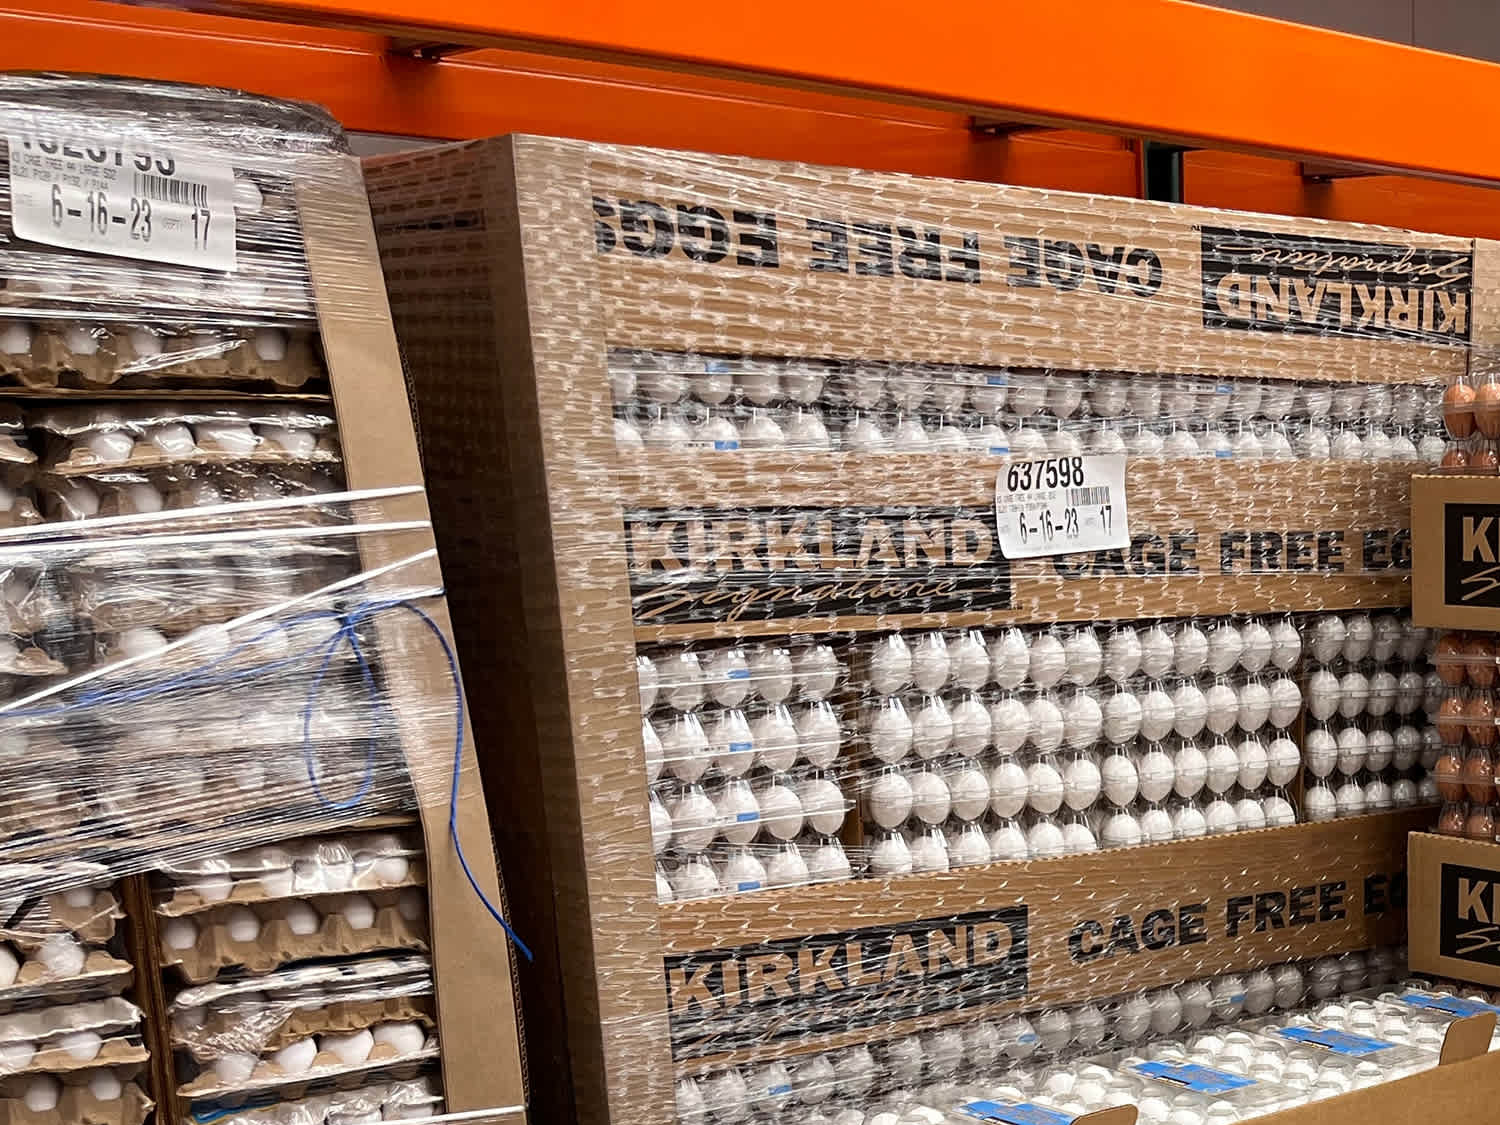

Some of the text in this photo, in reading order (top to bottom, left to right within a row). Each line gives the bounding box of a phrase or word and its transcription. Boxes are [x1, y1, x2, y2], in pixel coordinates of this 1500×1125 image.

[51, 183, 153, 243] 6-16-23
[191, 206, 212, 250] 17
[592, 197, 1163, 298] CAGE FREE EGGS
[1217, 270, 1468, 335] KIRKLAND
[1007, 456, 1084, 492] 637598
[627, 516, 997, 578] KIRKLAND
[1019, 507, 1080, 545] 6-16-23
[1099, 504, 1112, 537] 17
[1051, 529, 1413, 583] CAGE FREE EG
[1067, 880, 1347, 964] CAGE FREE
[668, 920, 1014, 1013] KIRKLAND
